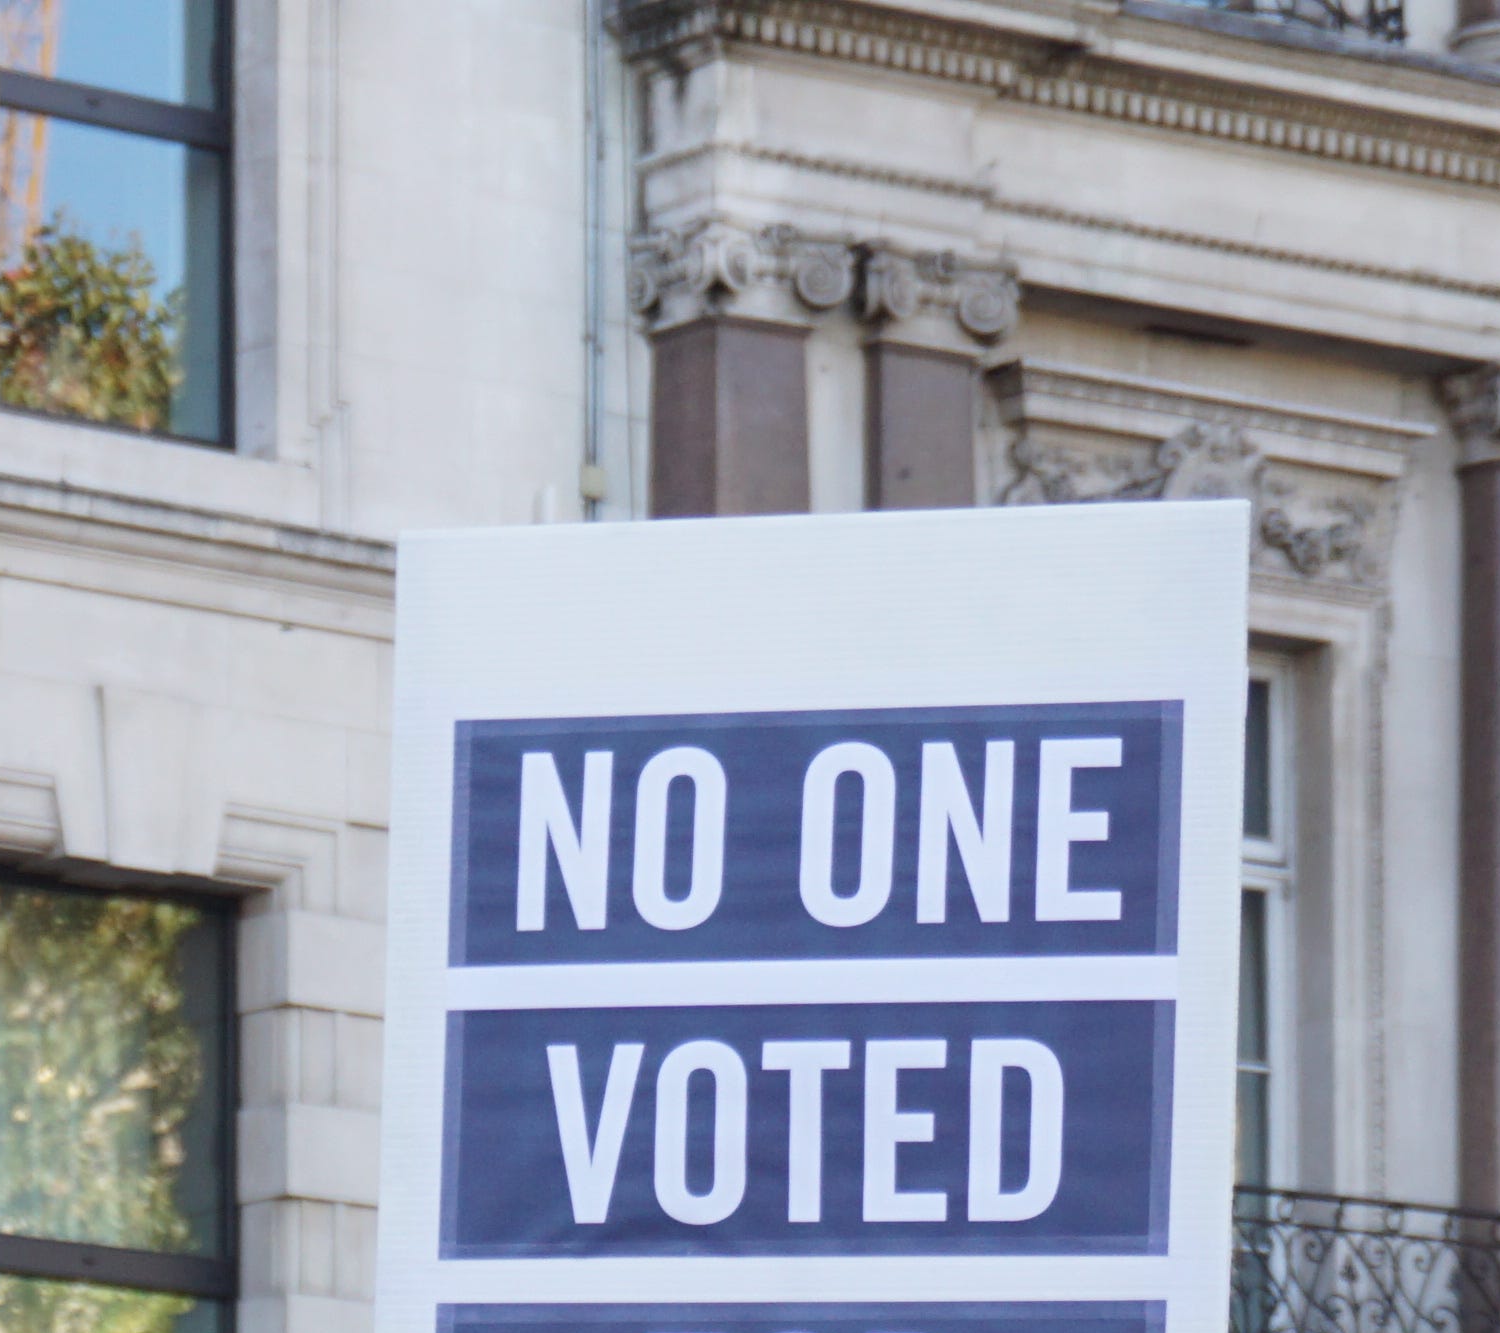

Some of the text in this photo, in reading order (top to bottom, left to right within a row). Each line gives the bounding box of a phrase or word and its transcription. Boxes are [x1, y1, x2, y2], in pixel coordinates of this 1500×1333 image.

[515, 736, 1124, 933] NO ONE
[545, 1036, 1065, 1226] VOTED
